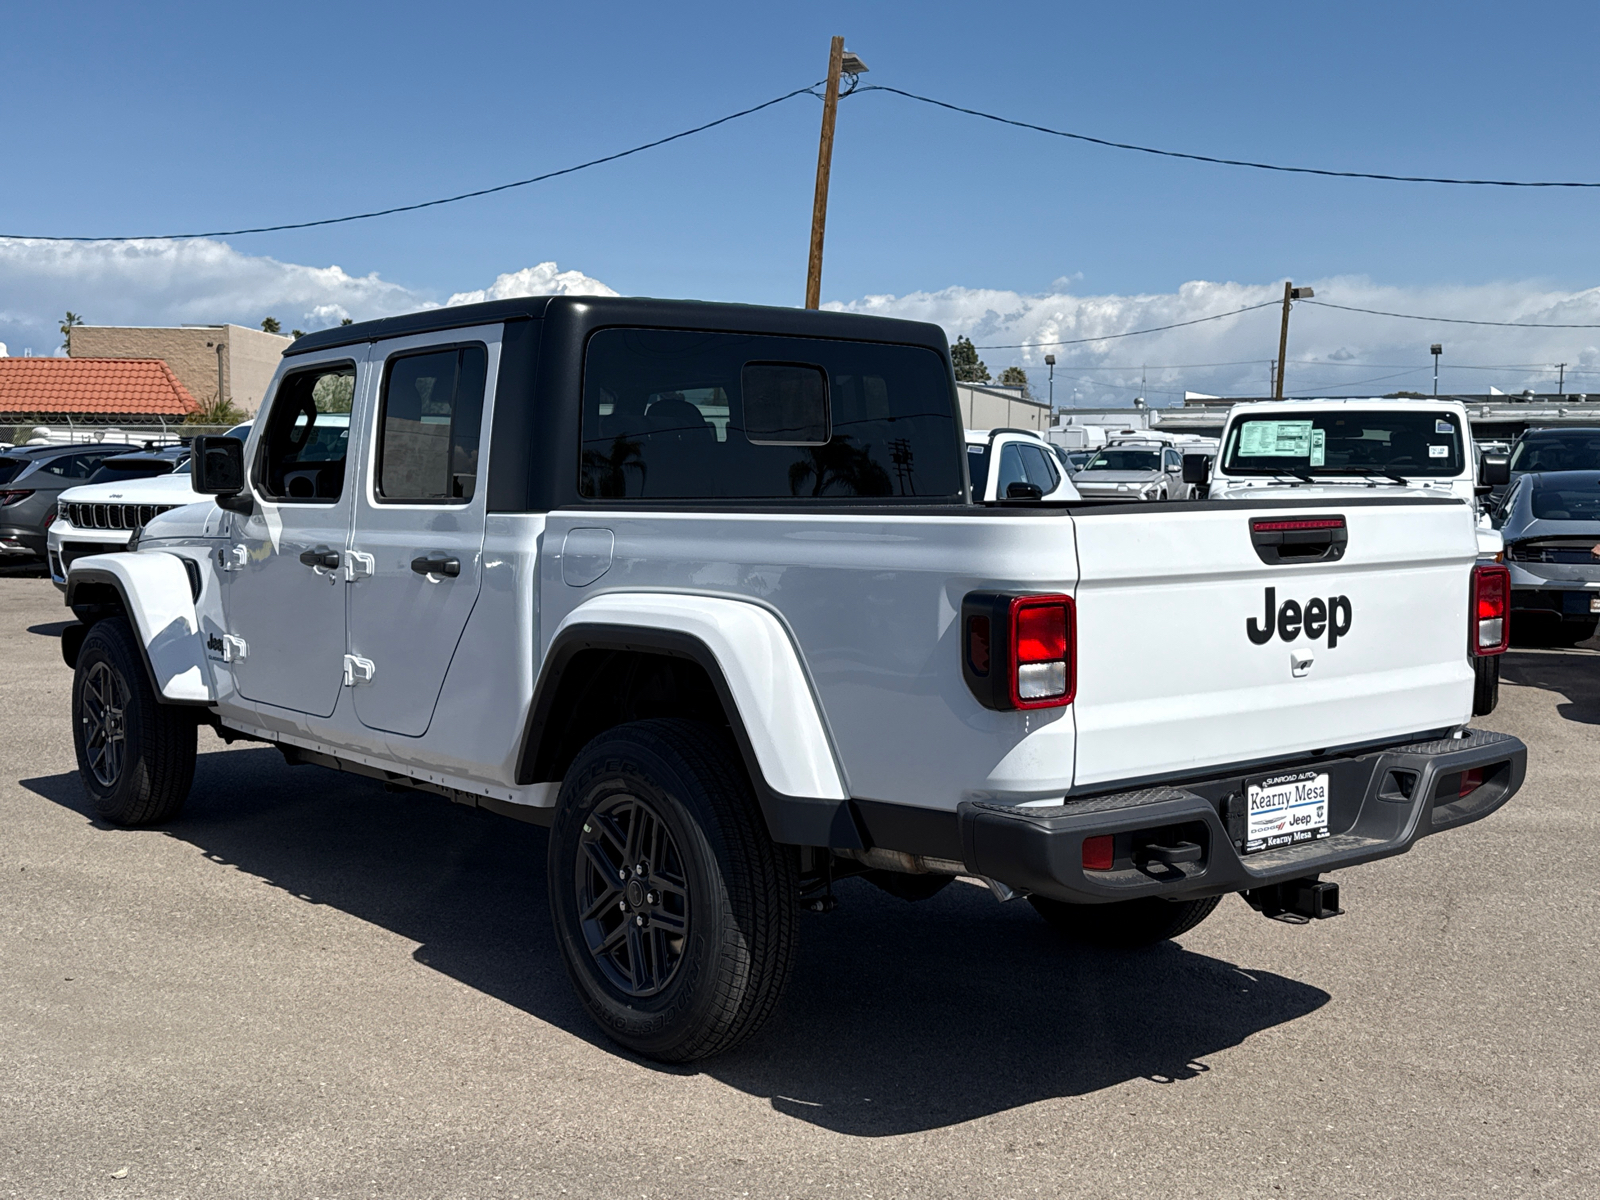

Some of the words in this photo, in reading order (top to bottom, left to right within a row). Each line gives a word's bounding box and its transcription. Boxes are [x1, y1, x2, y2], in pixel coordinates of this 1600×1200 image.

[1246, 586, 1352, 649] Jeep
[1266, 774, 1297, 785] SUNROAD
[1298, 771, 1315, 780] AUTO
[1250, 791, 1292, 811] Kearny
[1295, 784, 1325, 802] Mesa
[1289, 813, 1312, 827] Jeep
[1267, 834, 1293, 846] Kearny
[1293, 831, 1312, 841] Mesa
[588, 934, 704, 1037] BRIDGESTONE
